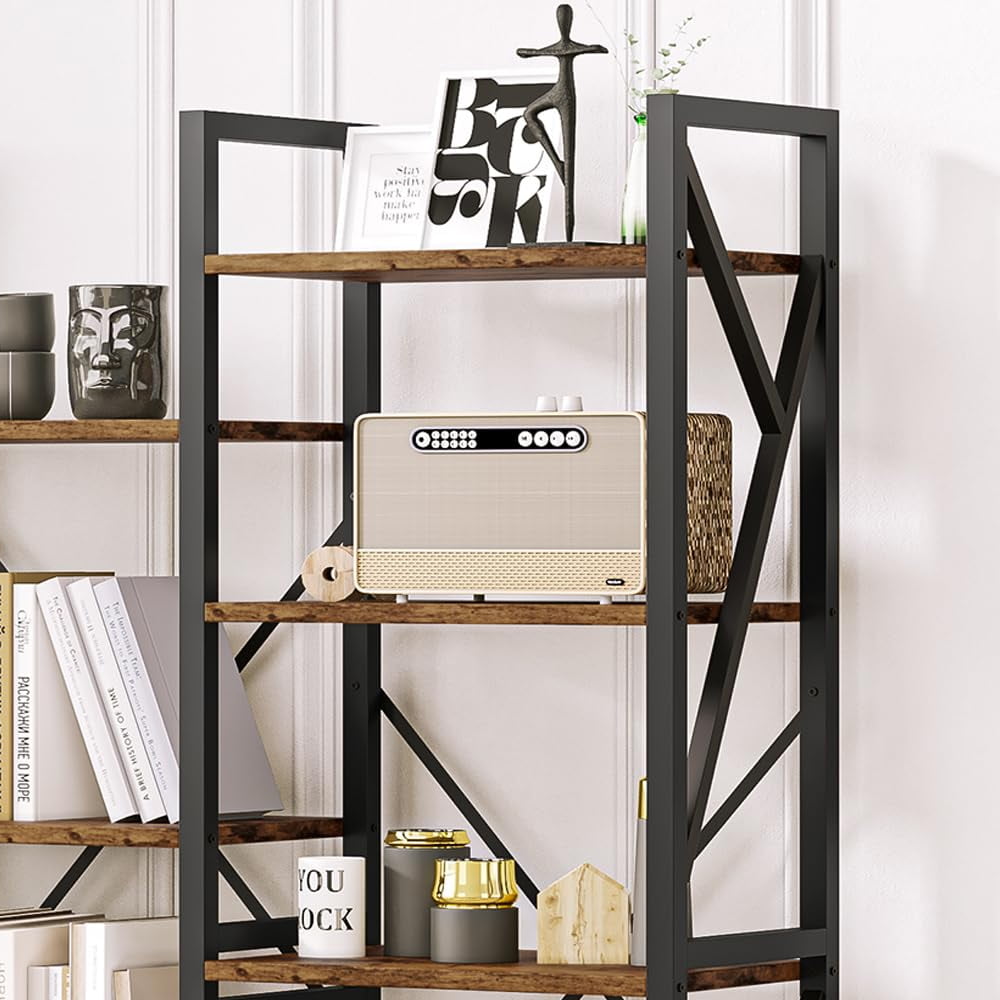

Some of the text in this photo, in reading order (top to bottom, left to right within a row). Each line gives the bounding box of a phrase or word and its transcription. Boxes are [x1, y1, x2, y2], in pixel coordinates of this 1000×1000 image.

[17, 676, 30, 734] РАССКАЖИ
[17, 737, 30, 760] МНЕ
[107, 687, 151, 802] A BRIEF HISTORY OF TIME
[17, 773, 30, 803] МОРЕ
[299, 869, 344, 893] YOU
[298, 907, 354, 931] OCK
